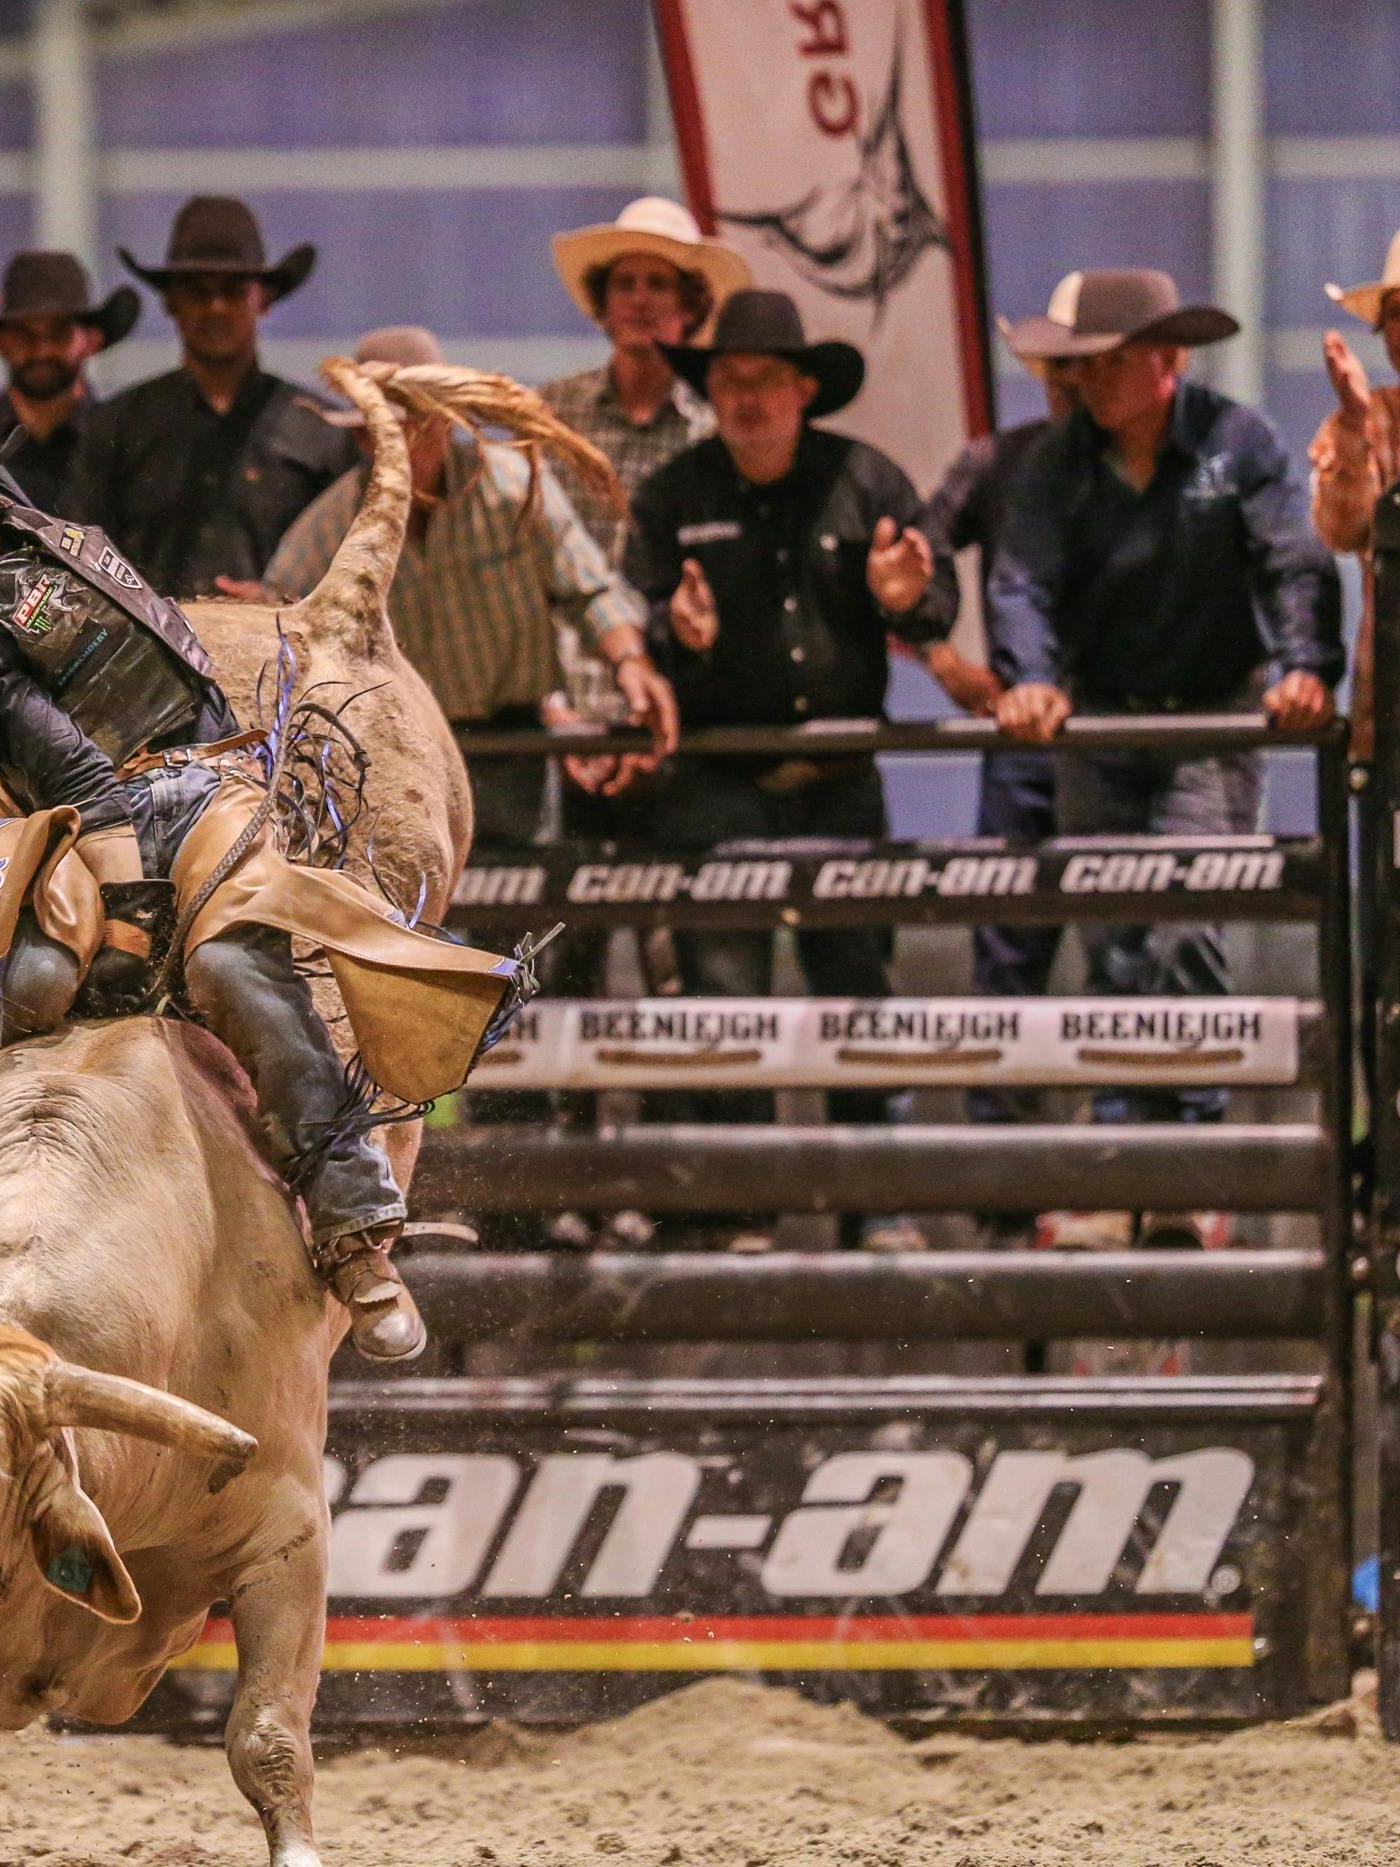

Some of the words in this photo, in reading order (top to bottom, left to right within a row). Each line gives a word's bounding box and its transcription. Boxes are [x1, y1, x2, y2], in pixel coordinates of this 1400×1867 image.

[565, 860, 794, 903] can-am
[811, 855, 1038, 899] can-am
[1058, 851, 1285, 894] can-am
[579, 1009, 781, 1048] BEENLEIGH
[818, 1009, 1022, 1049] BEENLEIGH
[1060, 1009, 1262, 1049] BEENLEIGH
[323, 1448, 1256, 1598] an-am
